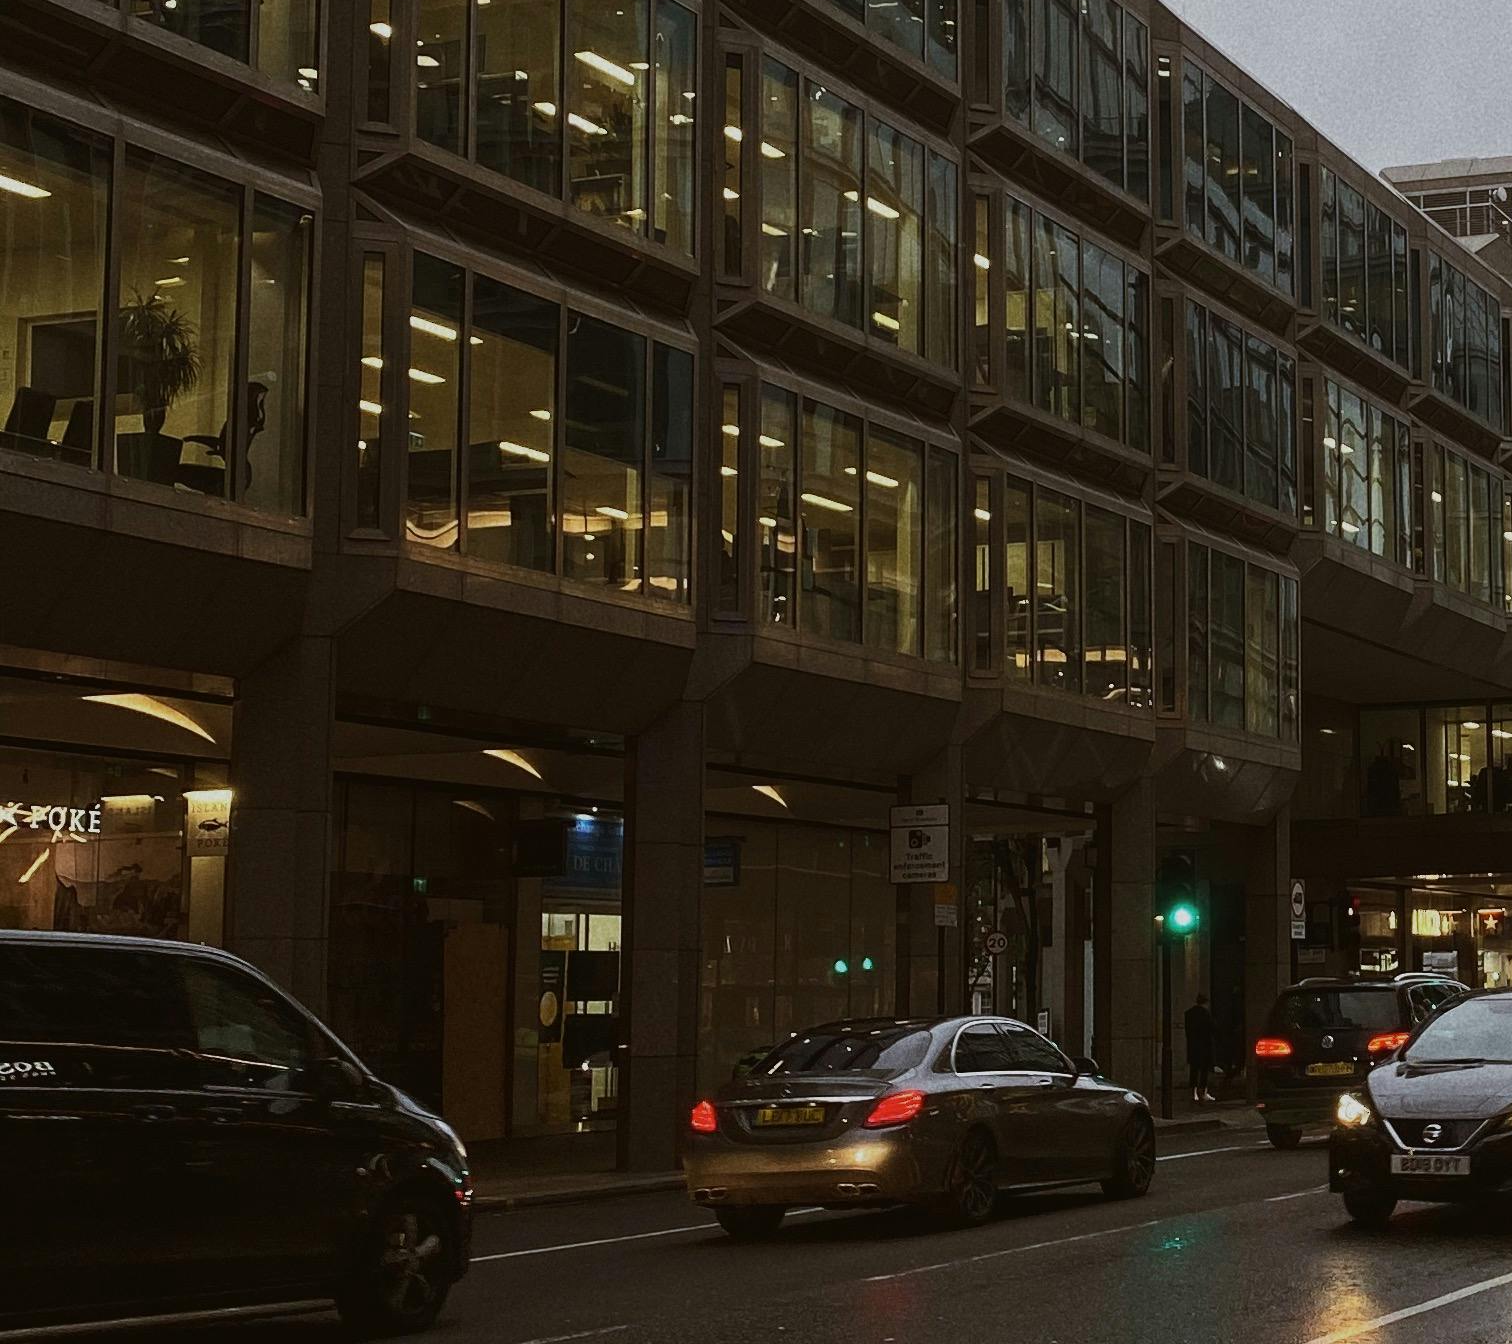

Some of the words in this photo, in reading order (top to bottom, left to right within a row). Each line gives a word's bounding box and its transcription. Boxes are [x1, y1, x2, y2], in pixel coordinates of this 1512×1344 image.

[29, 804, 101, 833] POKÉ
[905, 853, 933, 861] Traffic
[894, 861, 946, 870] enforcement
[989, 937, 1006, 948] 20
